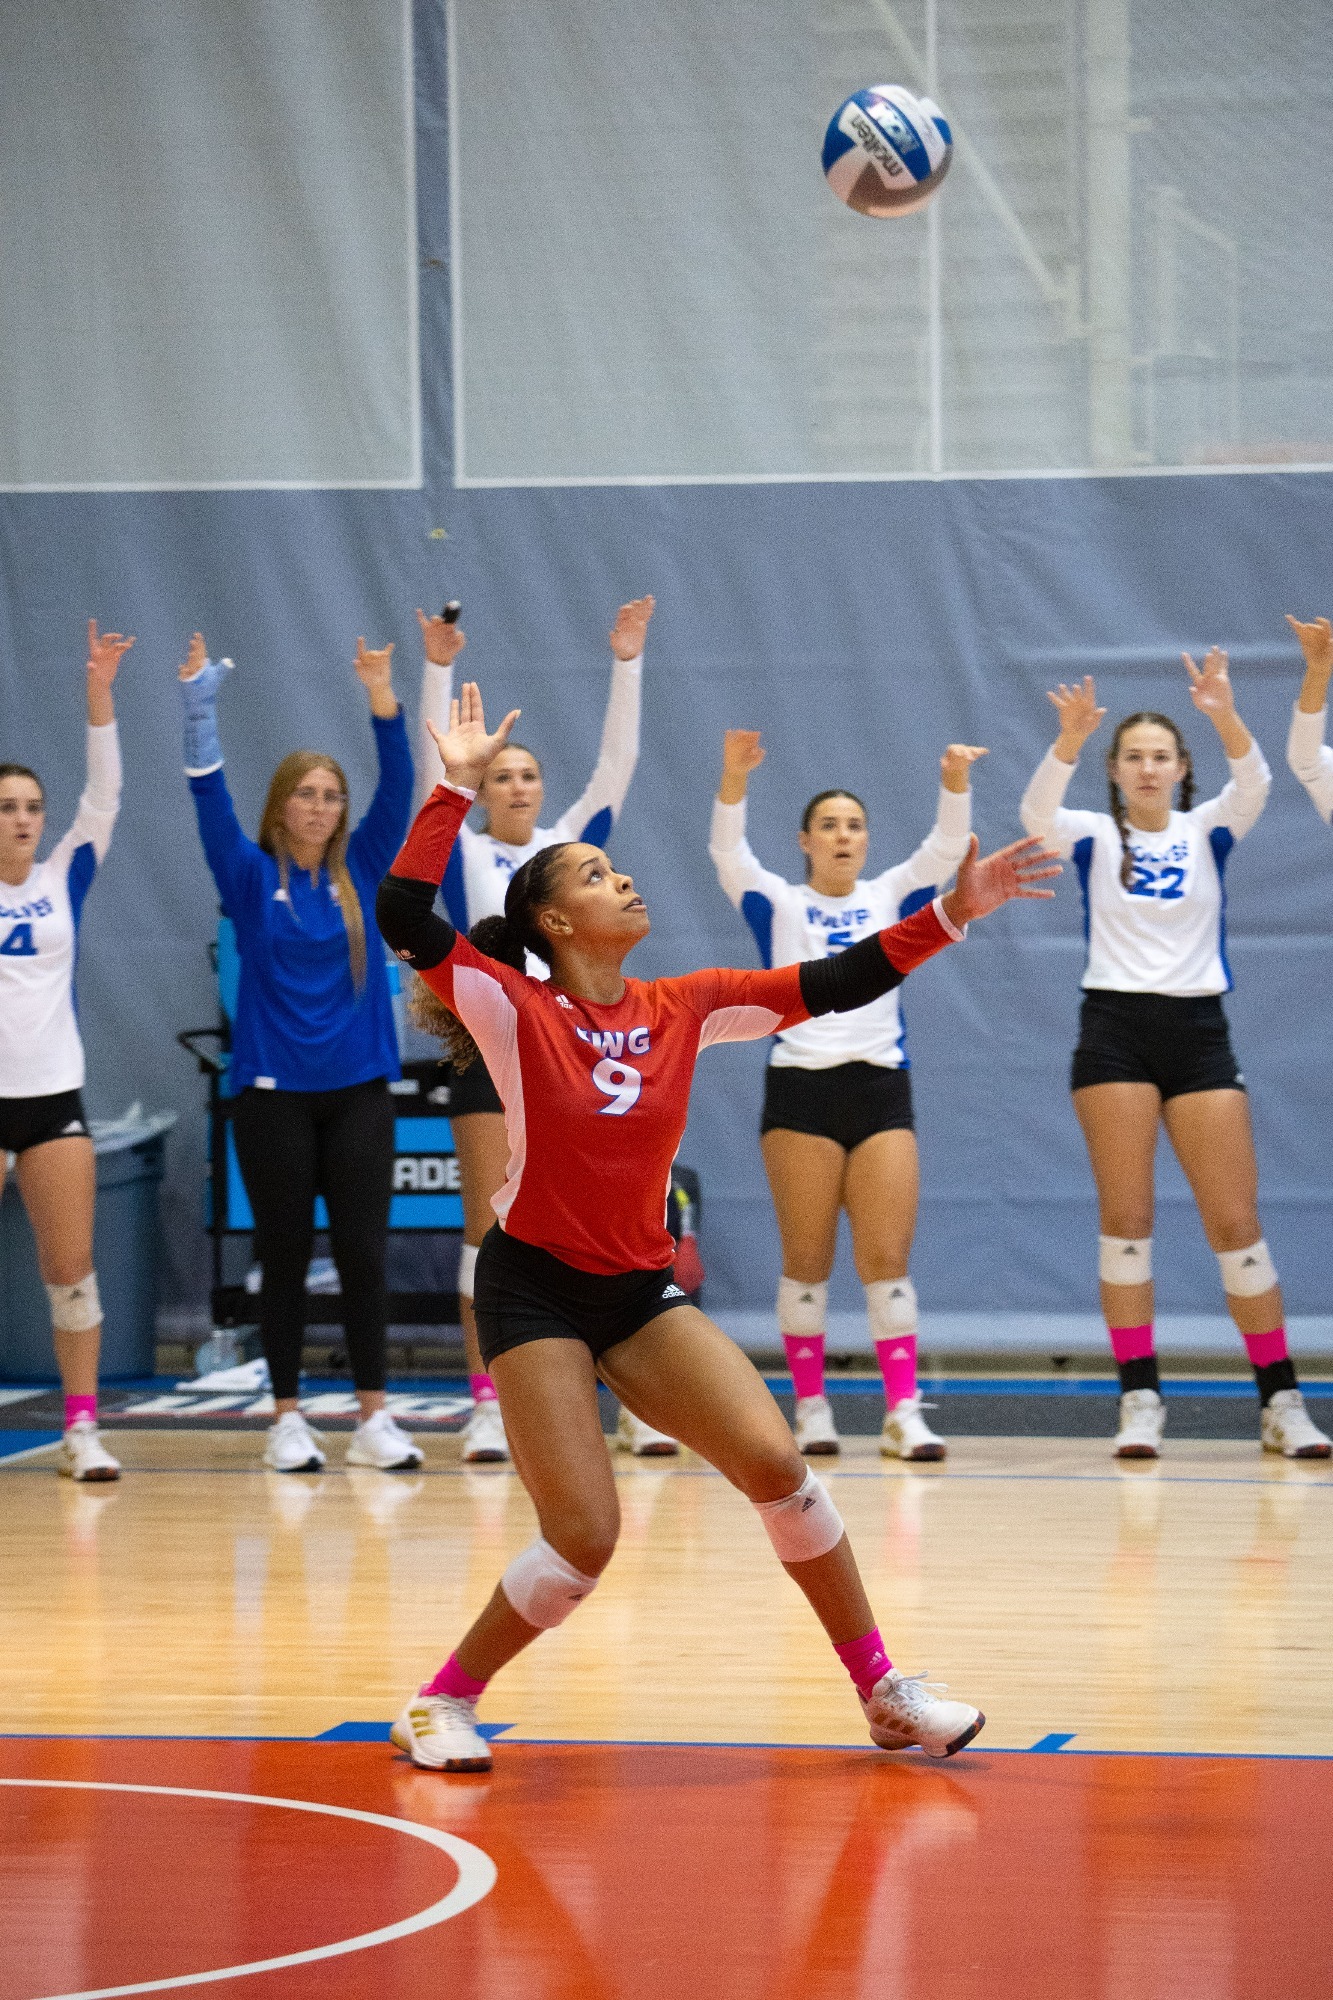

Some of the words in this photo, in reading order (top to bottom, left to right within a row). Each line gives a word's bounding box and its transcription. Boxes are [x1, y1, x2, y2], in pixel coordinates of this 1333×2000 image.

[850, 114, 903, 178] molten
[1127, 865, 1185, 899] 22
[0, 922, 38, 956] 4
[593, 1057, 642, 1117] 9
